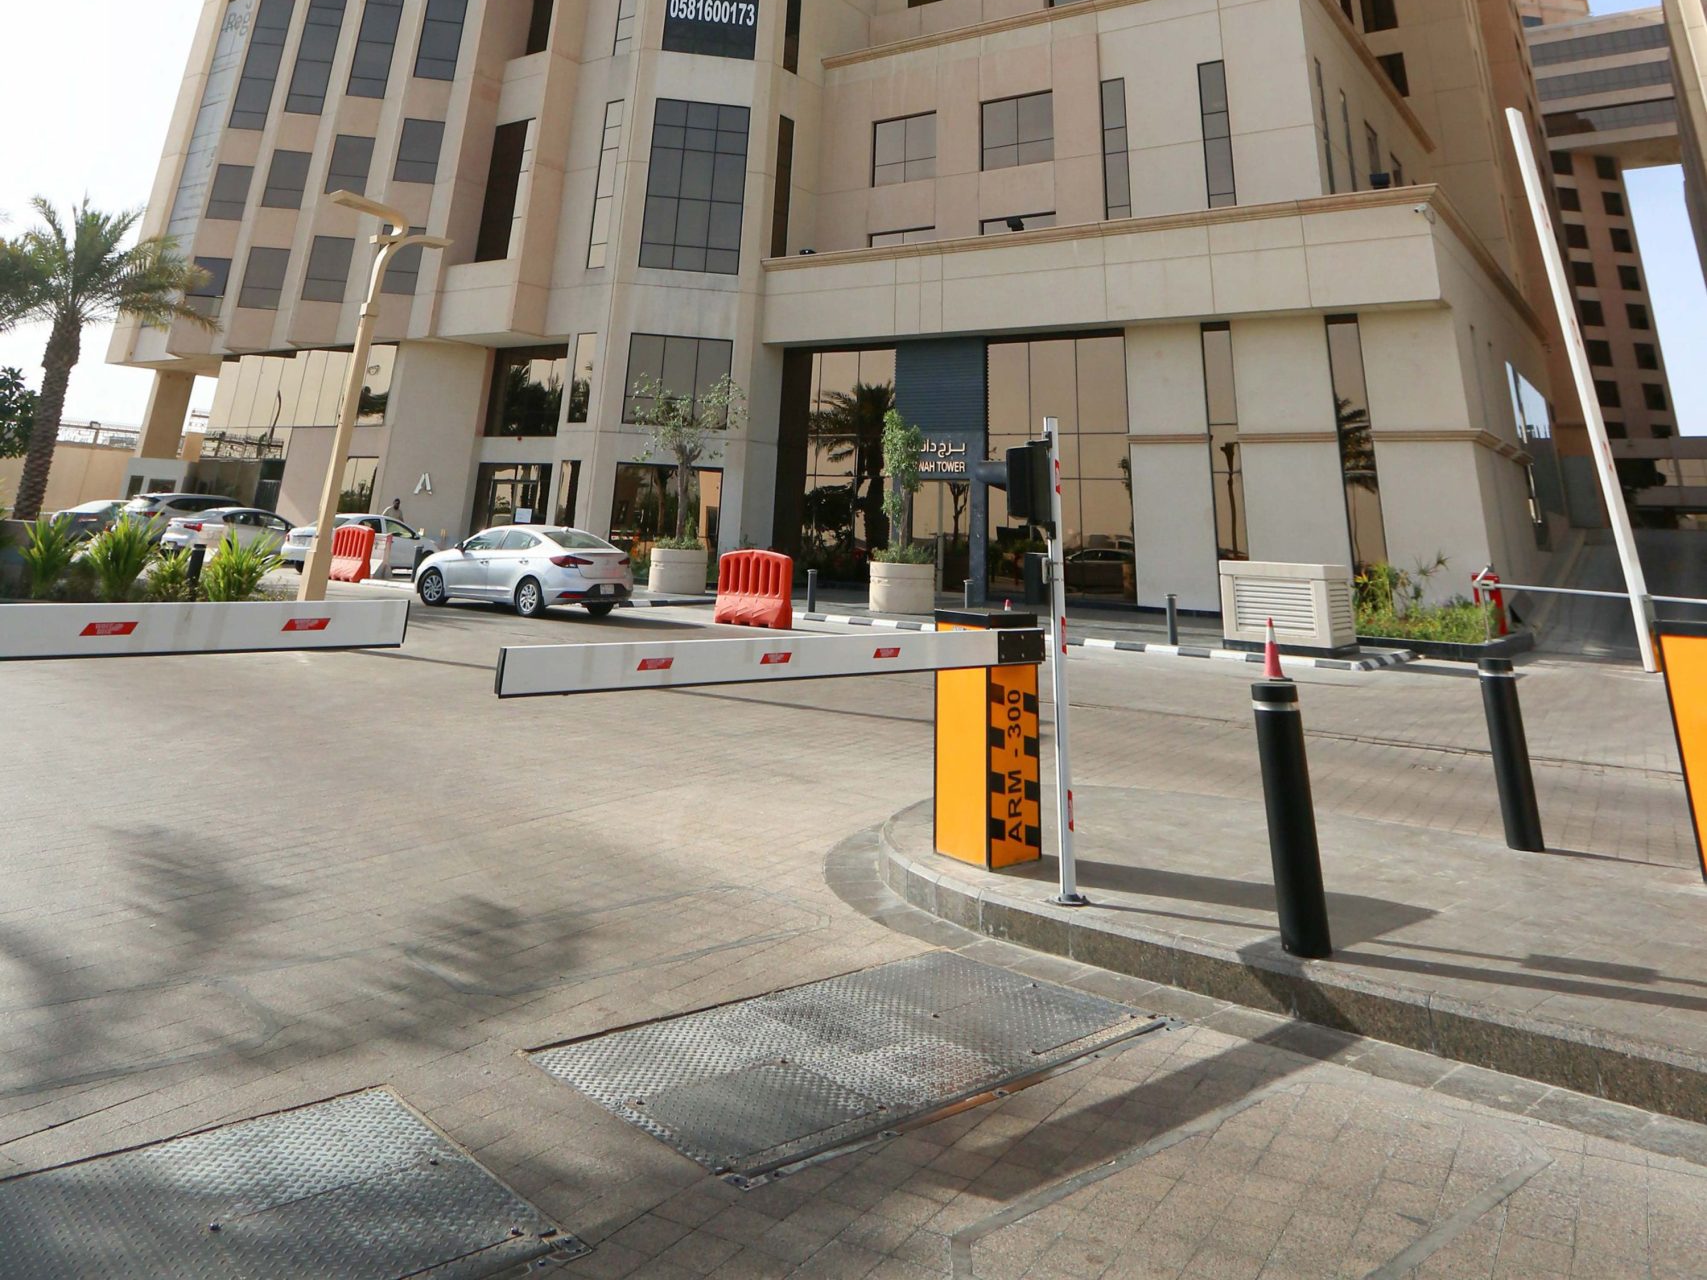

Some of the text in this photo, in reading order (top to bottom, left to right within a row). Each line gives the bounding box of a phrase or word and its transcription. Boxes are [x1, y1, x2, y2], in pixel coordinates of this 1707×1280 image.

[937, 441, 967, 458] برج
[936, 461, 966, 472] TOWER
[1007, 689, 1022, 739] 300
[1007, 769, 1023, 844] ARM
